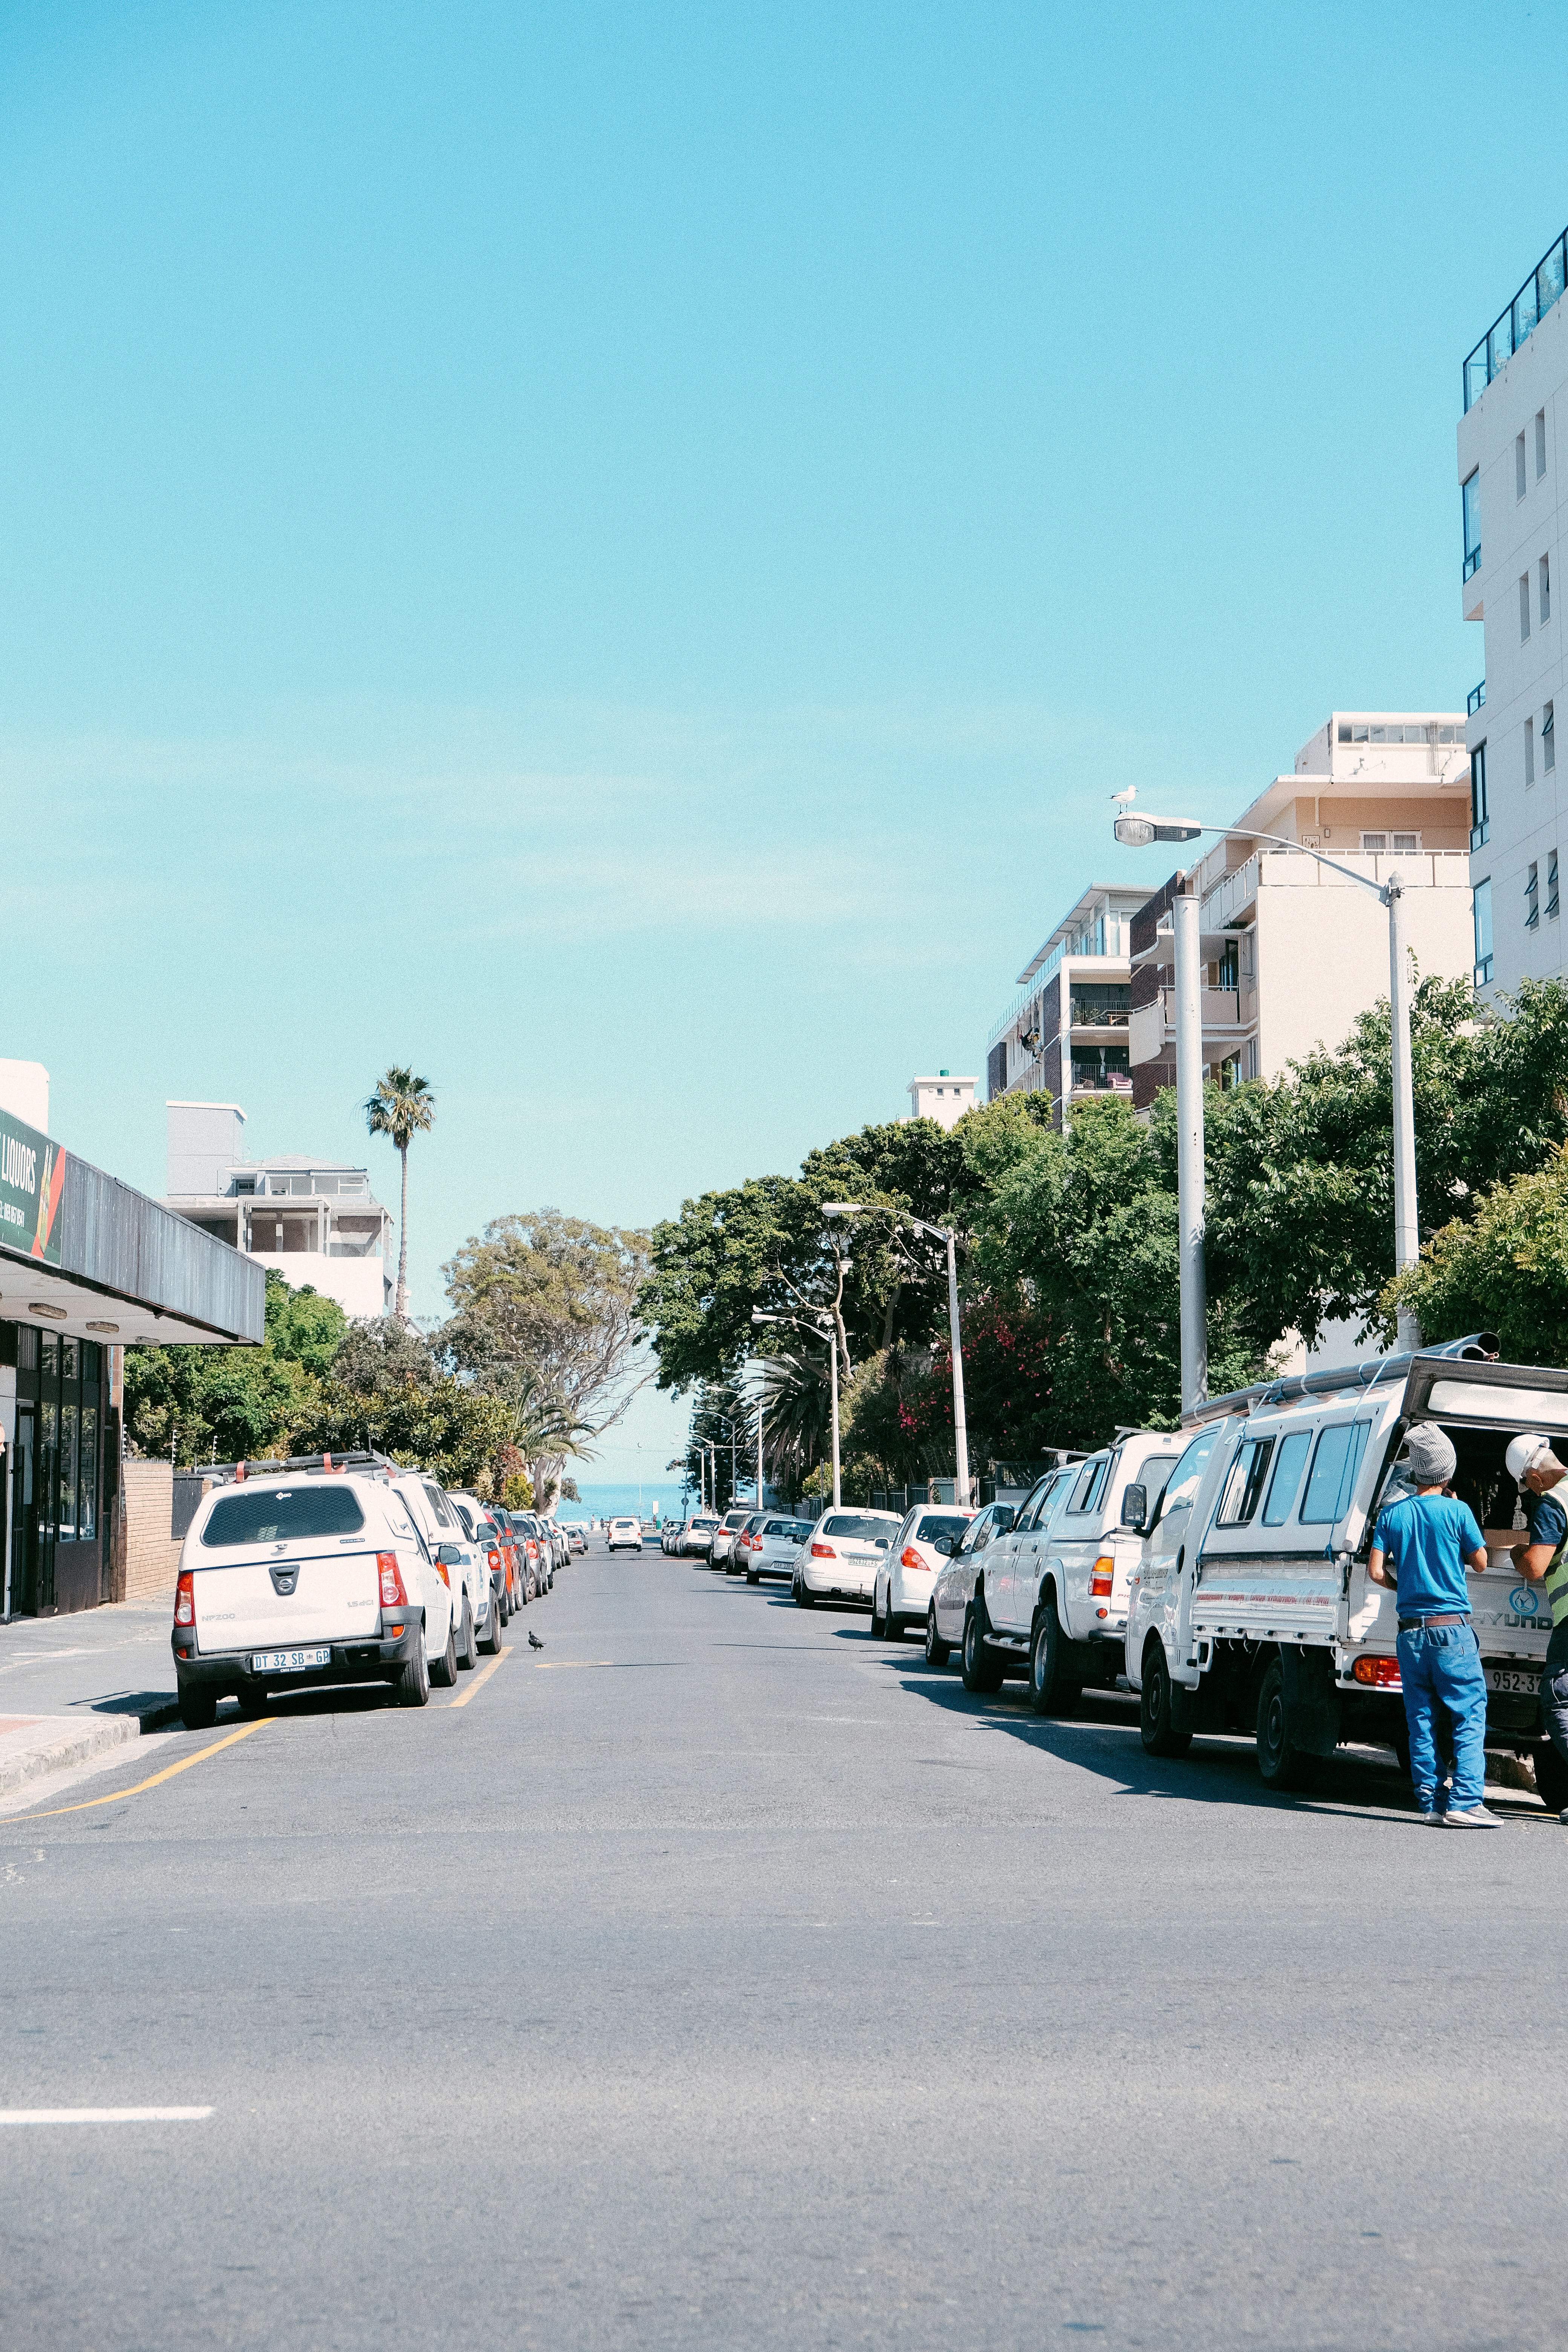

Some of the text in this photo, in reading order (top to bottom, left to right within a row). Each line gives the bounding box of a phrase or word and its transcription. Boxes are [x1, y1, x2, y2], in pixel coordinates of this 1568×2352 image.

[2, 1134, 36, 1195] LIQUORS
[1470, 1612, 1553, 1630] HYUND
[255, 1650, 329, 1668] DT 32 SB GP
